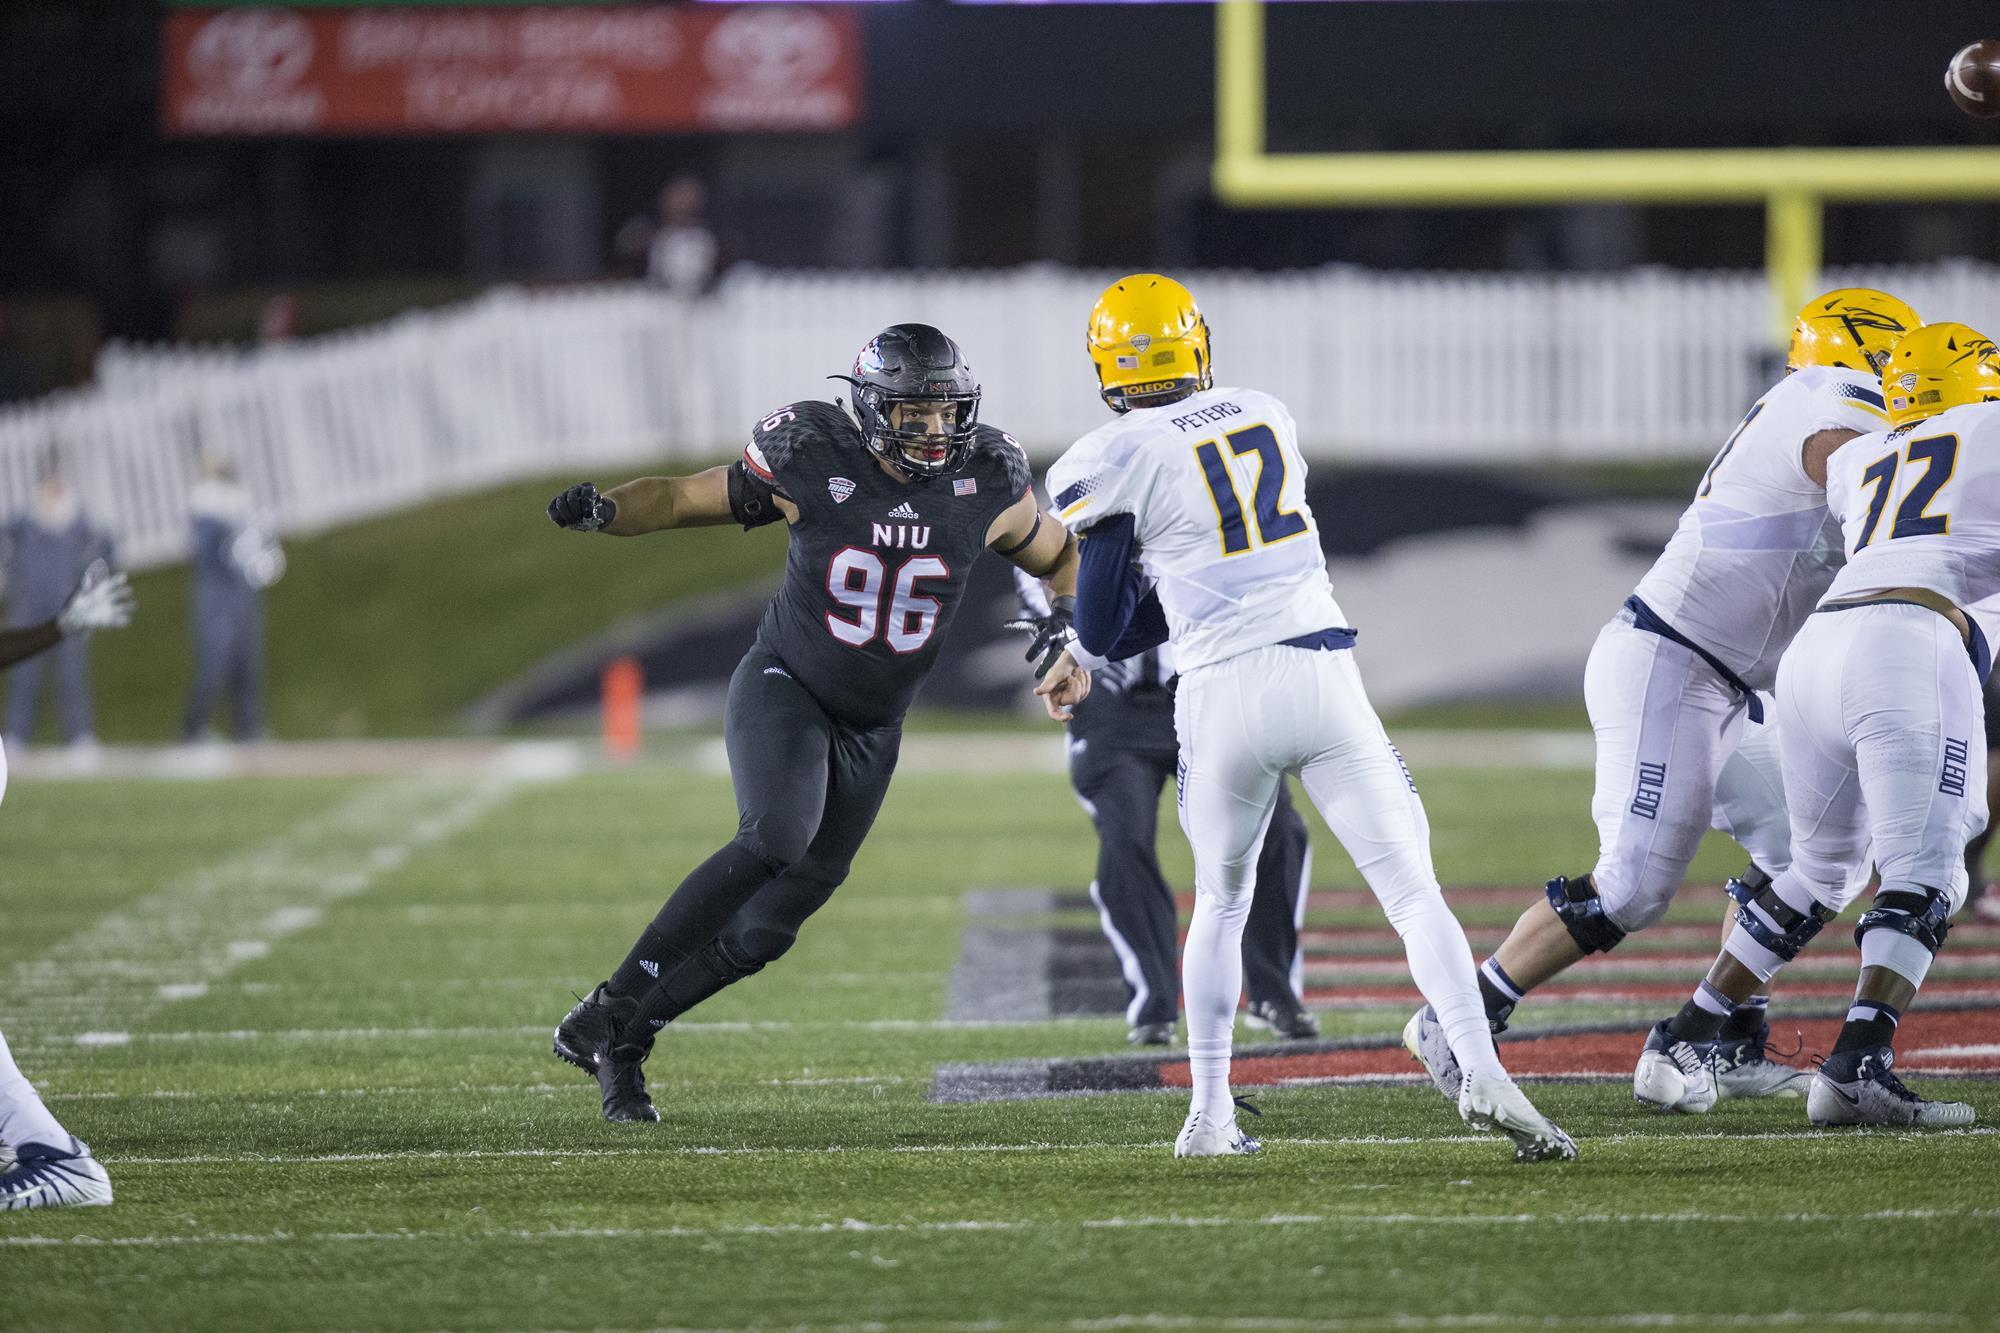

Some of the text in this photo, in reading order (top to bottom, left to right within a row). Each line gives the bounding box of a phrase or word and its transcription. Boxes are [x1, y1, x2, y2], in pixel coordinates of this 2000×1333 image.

[1121, 381, 1176, 395] TOLEDO
[1171, 401, 1242, 432] PETERS
[888, 511, 919, 519] adidas
[1194, 422, 1310, 557] 12
[1853, 431, 1961, 556] 72
[871, 521, 931, 550] NIU
[825, 544, 950, 655] 96
[1630, 762, 1666, 820] TOLEDO
[1939, 737, 1968, 798] TOLEDO
